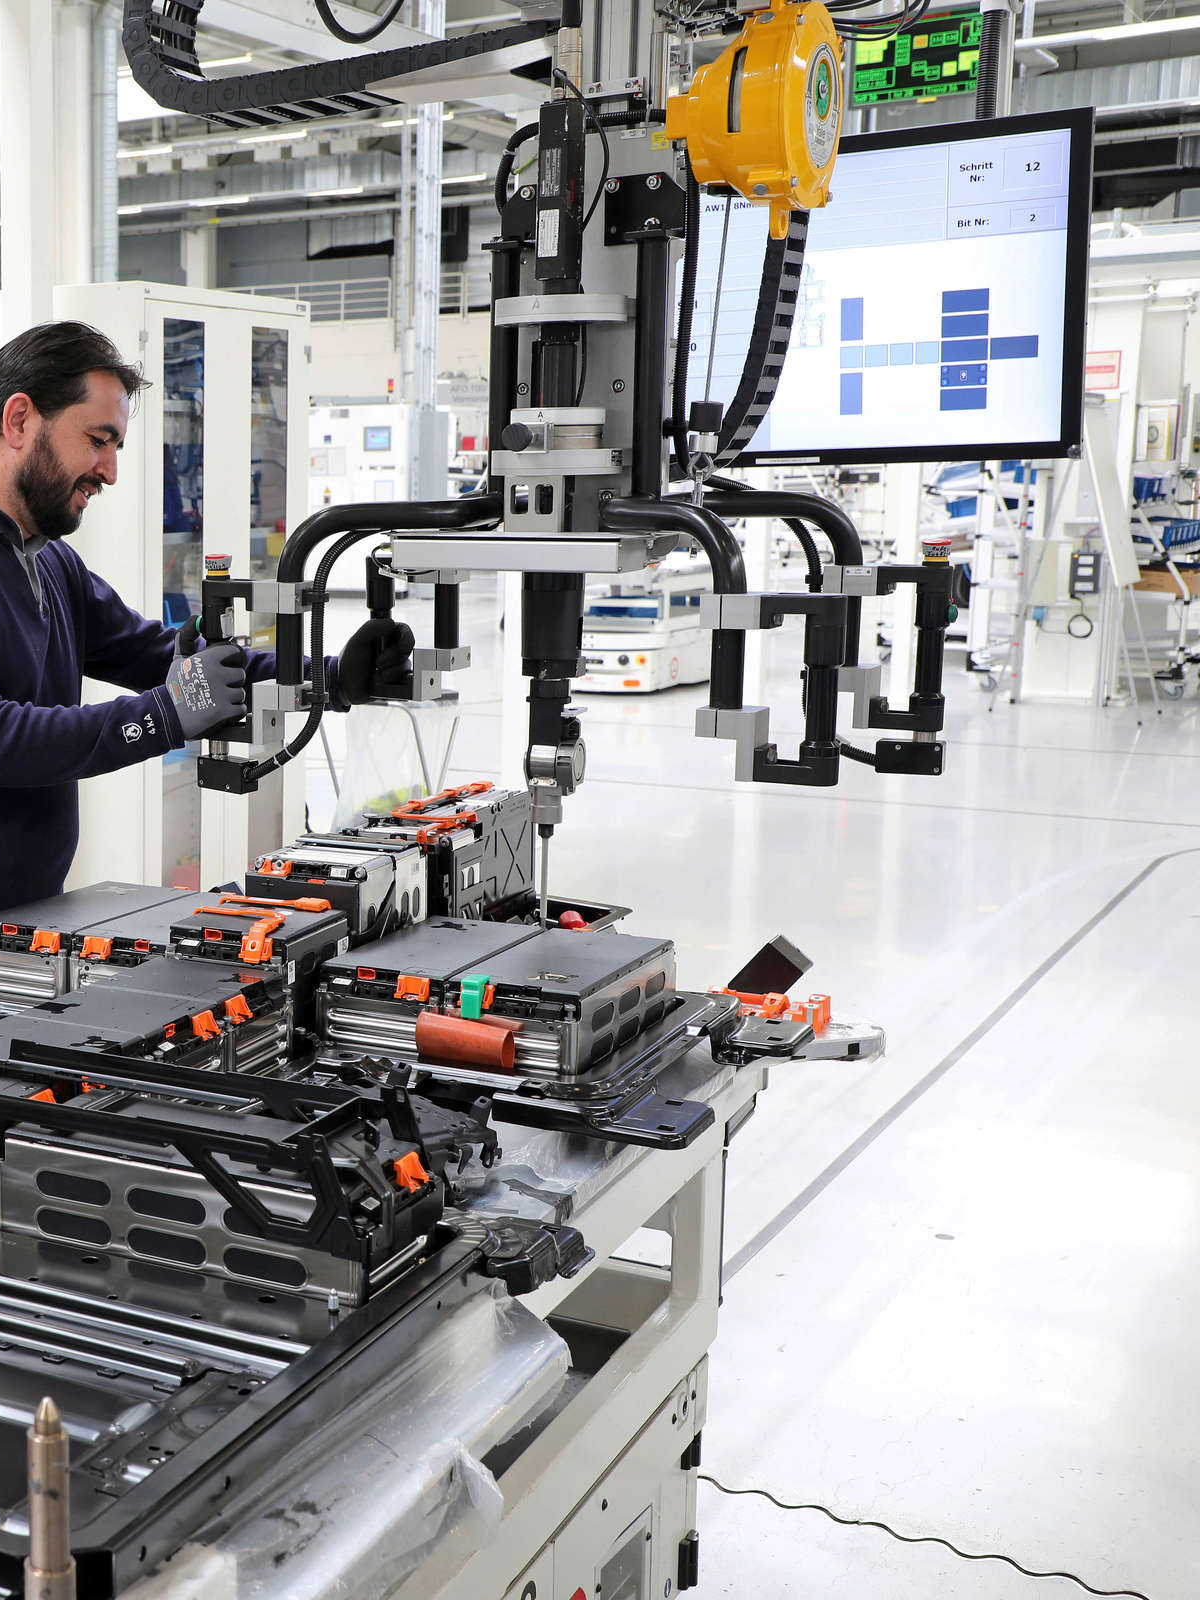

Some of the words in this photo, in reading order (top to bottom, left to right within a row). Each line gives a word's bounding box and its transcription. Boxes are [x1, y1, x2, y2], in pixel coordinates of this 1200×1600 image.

[959, 161, 994, 173] Schritt
[1025, 161, 1041, 172] 12
[969, 174, 985, 183] Nr:
[957, 219, 971, 228] Bit
[974, 217, 990, 226] Nr:
[1029, 213, 1036, 222] 2
[537, 411, 544, 419] A
